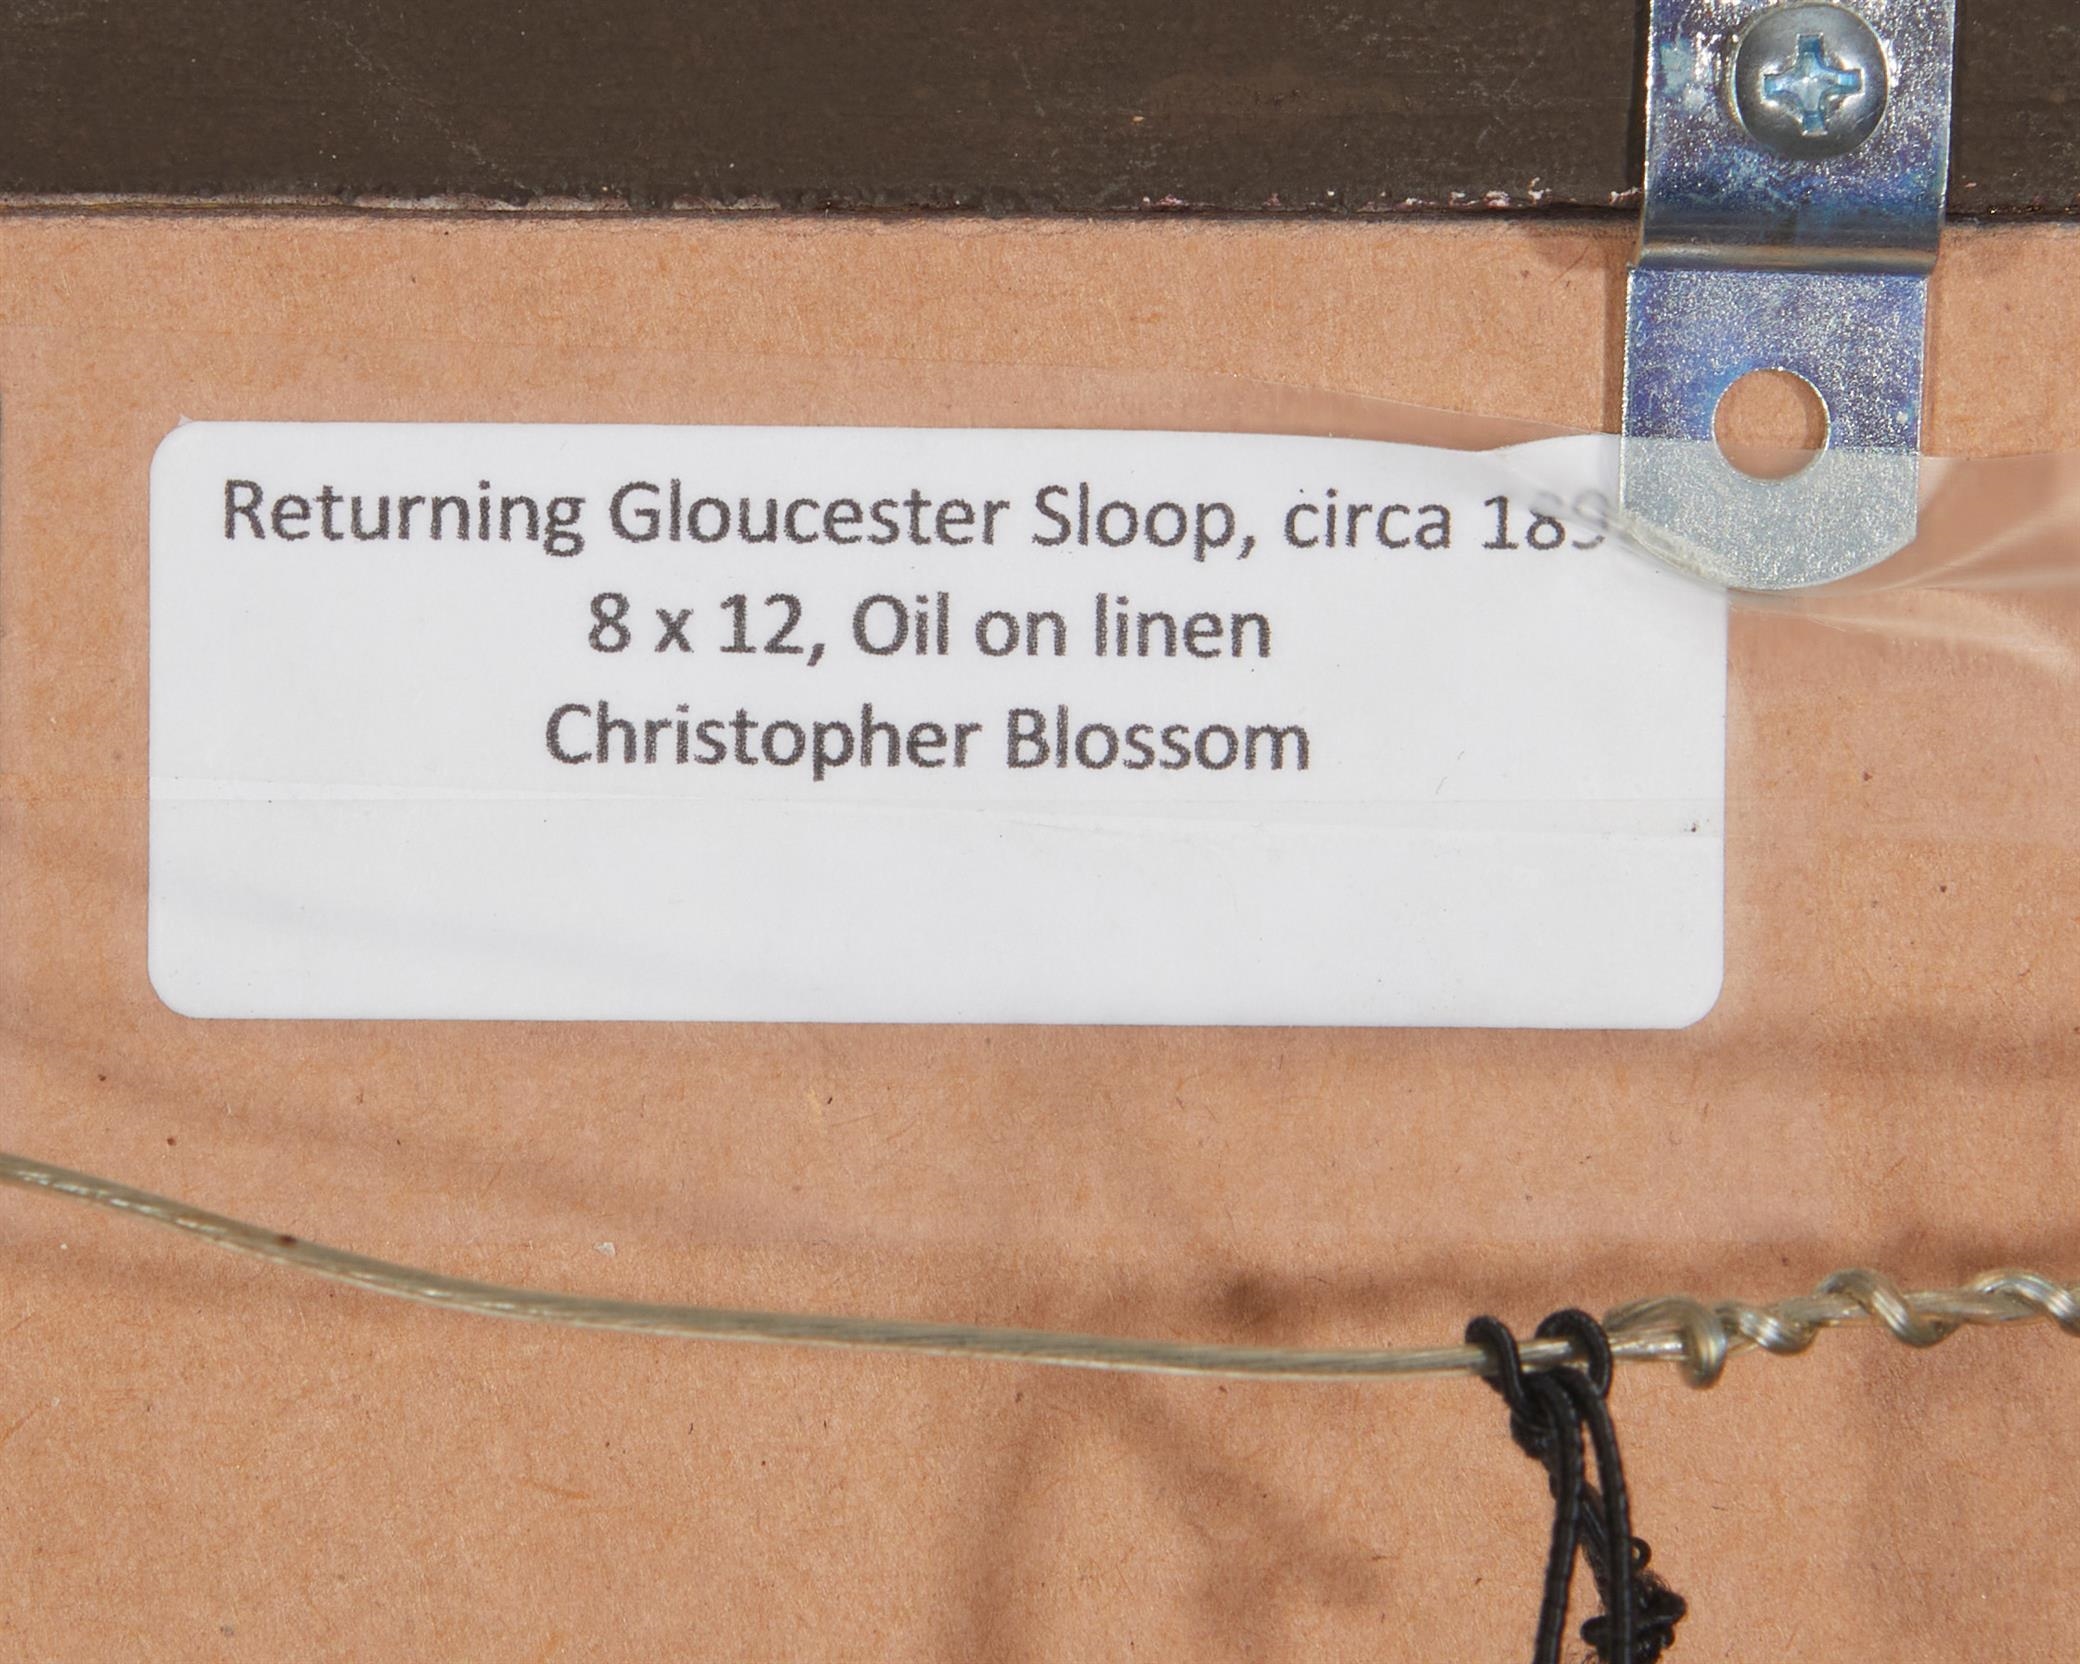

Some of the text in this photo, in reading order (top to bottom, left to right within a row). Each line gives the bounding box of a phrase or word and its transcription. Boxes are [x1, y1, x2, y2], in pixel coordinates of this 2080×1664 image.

[225, 478, 1610, 563] Returning Gloucester Sloop, circa 189
[588, 591, 1271, 667] 8 x 12, Oil on linen
[545, 700, 1310, 782] Christopher Blossom
